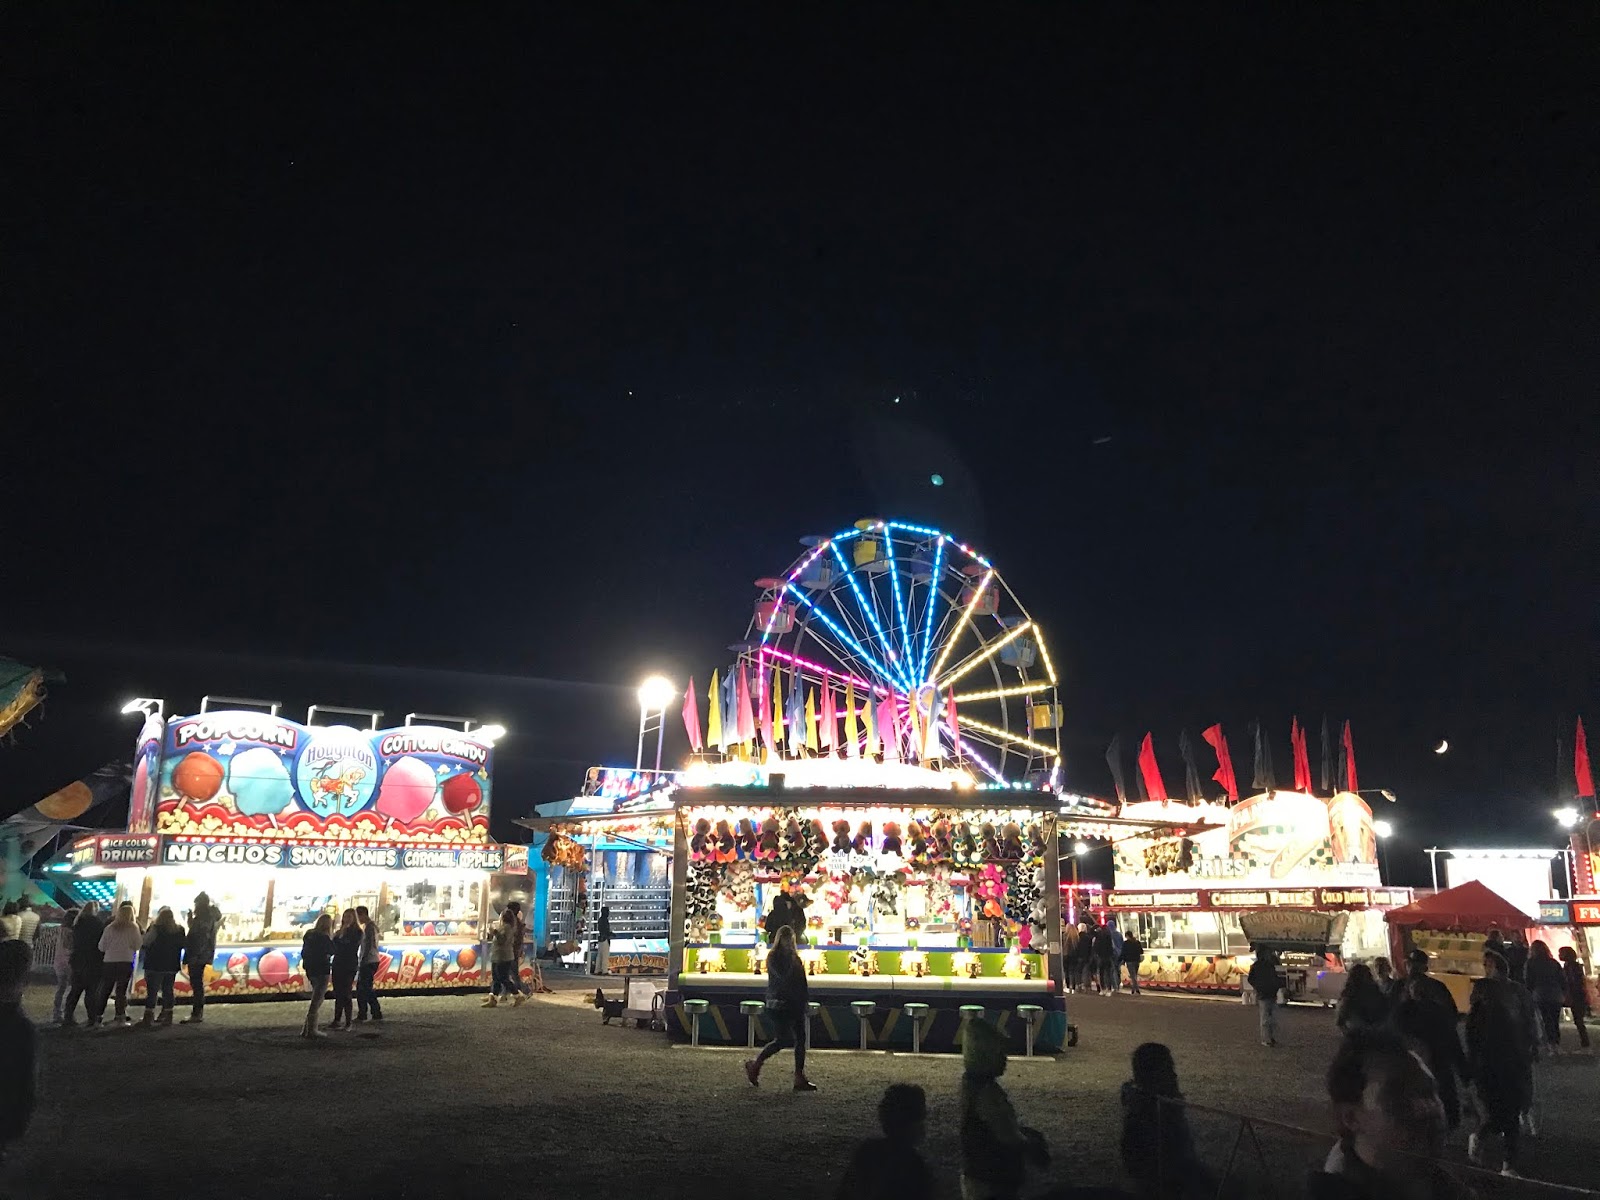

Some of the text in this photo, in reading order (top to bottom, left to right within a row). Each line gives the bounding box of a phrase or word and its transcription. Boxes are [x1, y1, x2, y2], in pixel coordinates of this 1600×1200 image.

[178, 721, 295, 748] POPCORN
[306, 744, 373, 769] Houghton
[382, 734, 487, 764] COTTON CANDY
[109, 839, 147, 847] ICE COLD
[101, 848, 154, 862] DRINKS
[167, 844, 283, 864] NACHOS
[290, 846, 397, 867] SNOW KONES
[403, 850, 456, 868] CARAMEL
[458, 851, 502, 869] APPLES
[1321, 890, 1343, 904] COLD
[1540, 908, 1564, 917] EPSI
